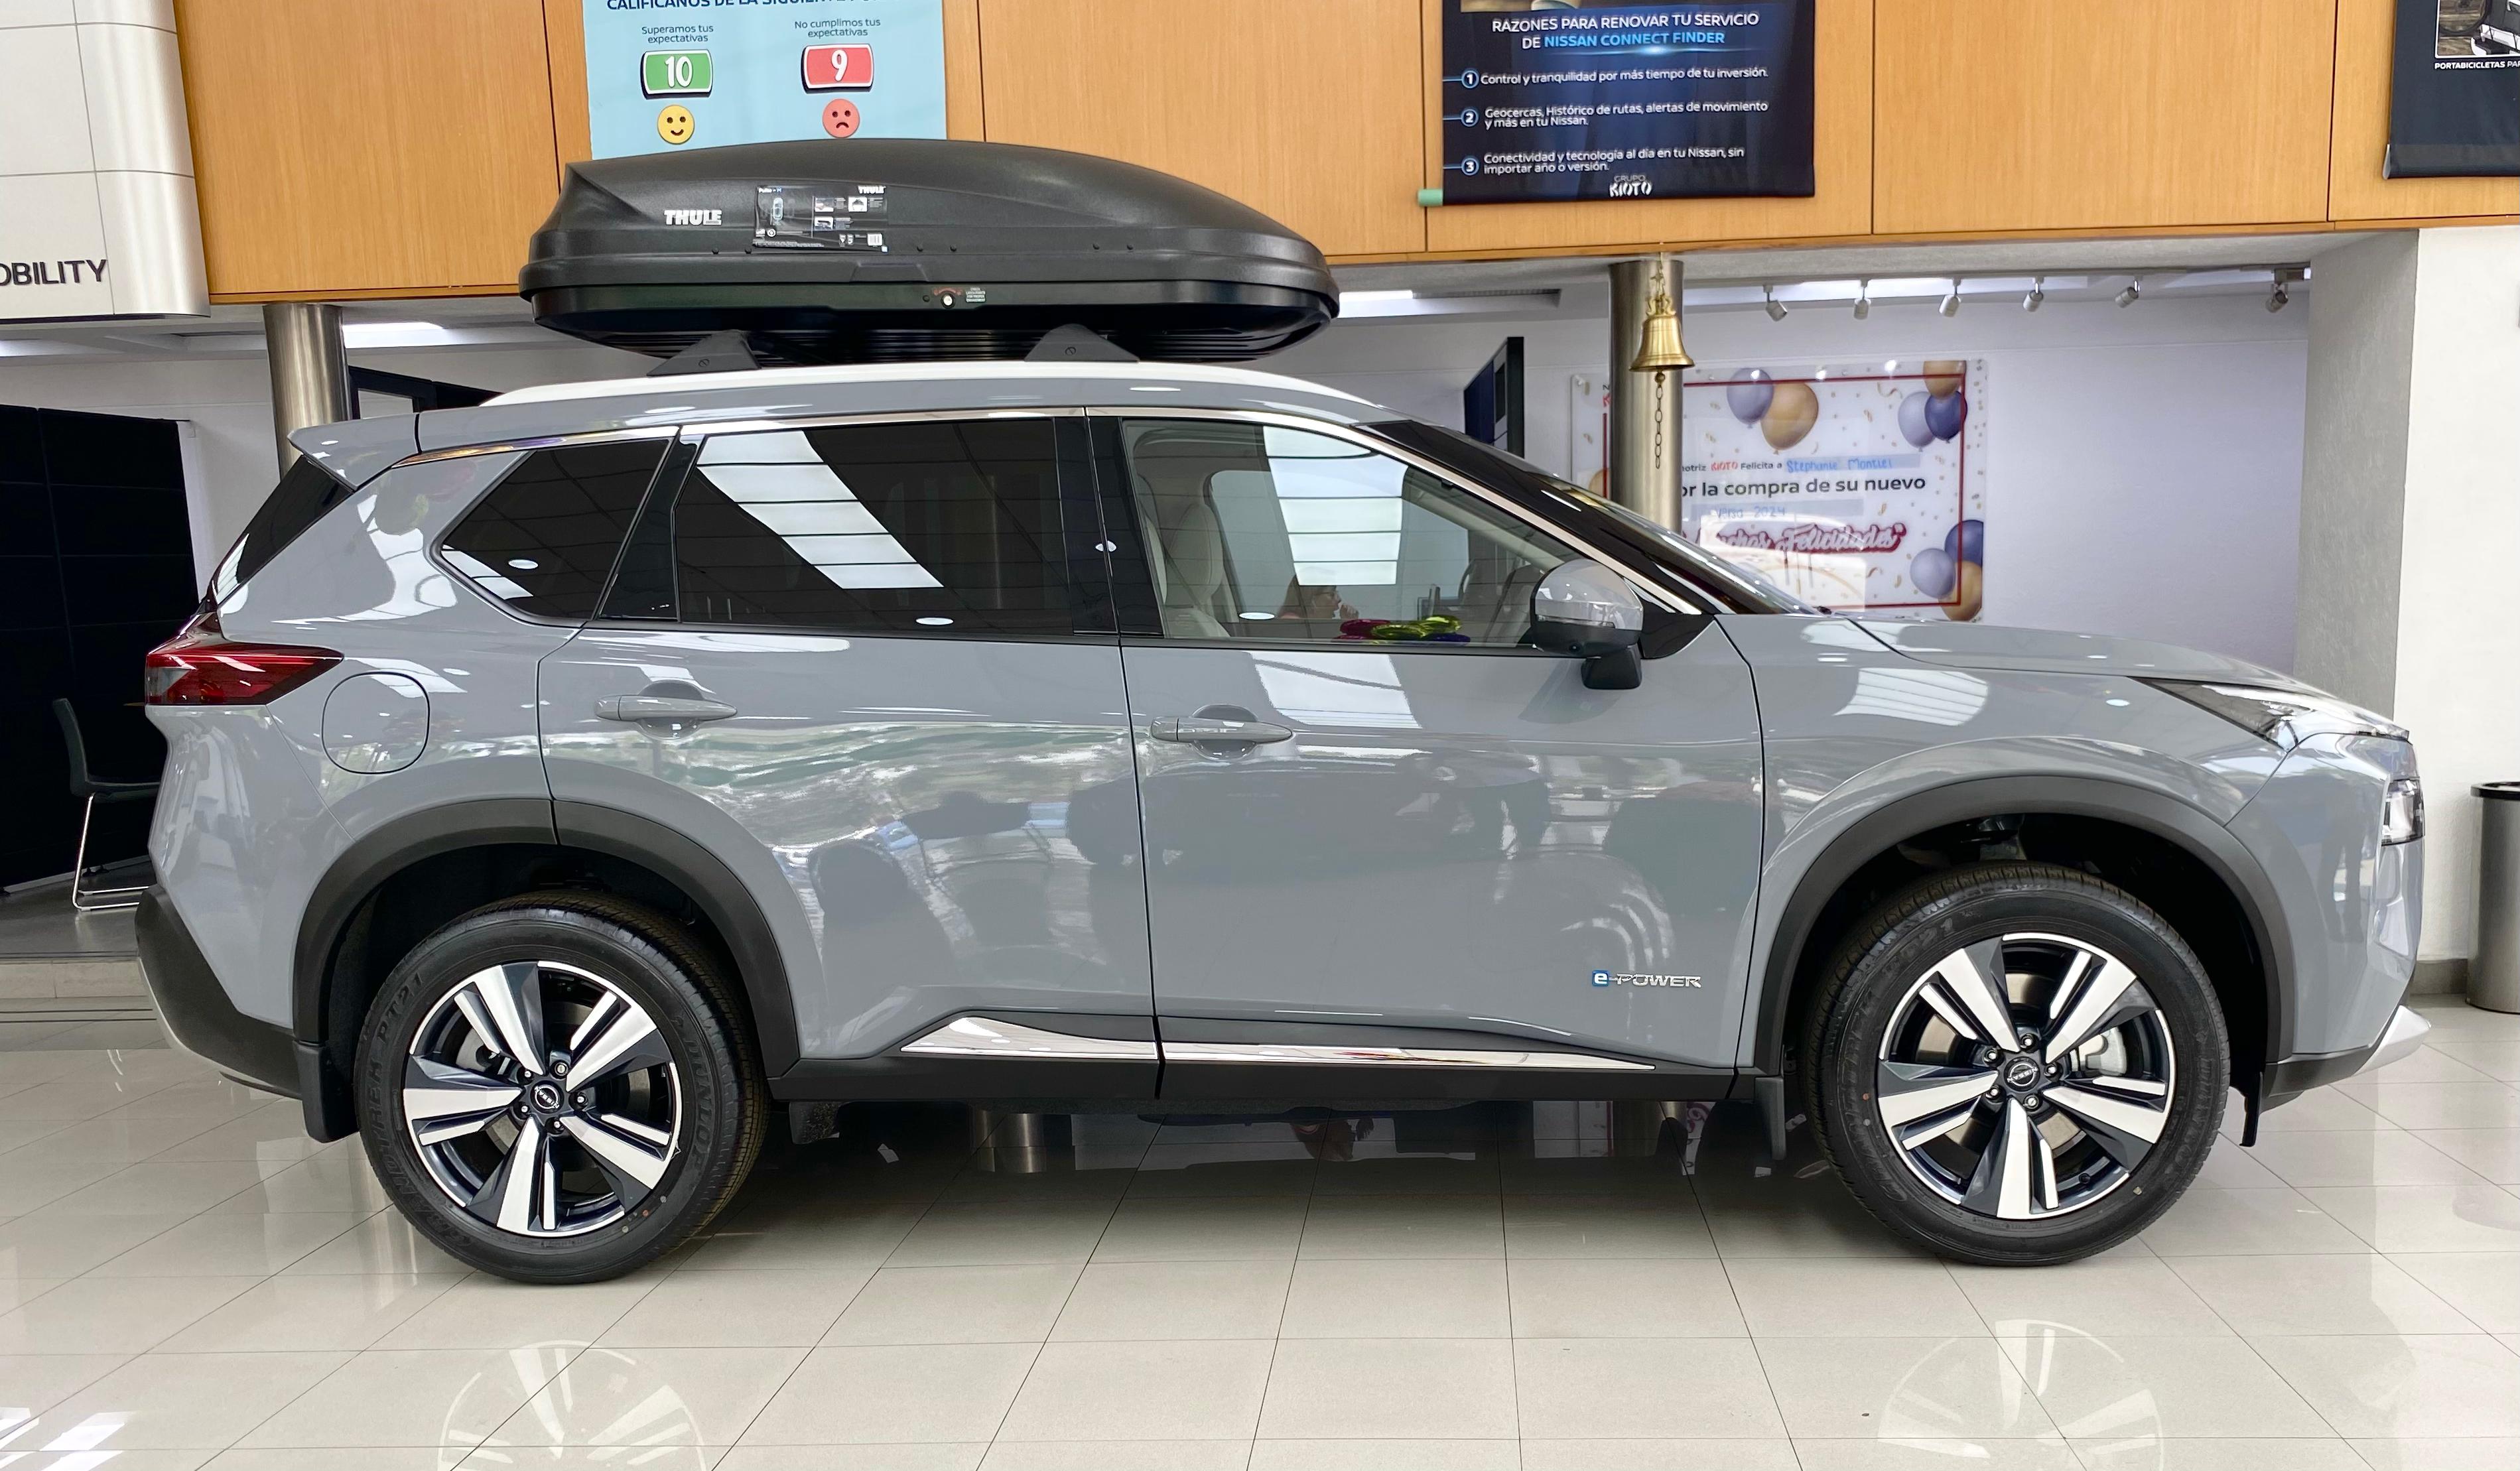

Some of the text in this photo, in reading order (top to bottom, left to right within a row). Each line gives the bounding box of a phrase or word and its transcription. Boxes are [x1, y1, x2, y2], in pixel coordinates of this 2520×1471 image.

[641, 25, 714, 35] Superamos tus
[795, 18, 881, 29] No cumplimos tus
[1492, 13, 1759, 32] RAZONES PARA RENOVAR TU SERVICIO
[647, 34, 708, 44] expectativas
[808, 28, 868, 39] expectativas
[1522, 32, 1725, 49] DE NISSAN CONNECT FINDER
[665, 55, 693, 88] 10
[831, 50, 848, 82] 9
[2434, 61, 2505, 70] PORTABICICLETAS
[1466, 66, 1768, 86] 1 Control y tranquilidad por más tiempo de tu inversión.
[1465, 101, 1768, 123] 2 Geocercas, Histórico de rutas, alertas de movimiento
[1485, 116, 1589, 130] y más en tu Nissan.
[1465, 147, 1745, 172] 3 Conectividad y tecnología al día en tu Nissan, sin
[1484, 161, 1609, 176] importar año o versión.
[858, 185, 886, 194] THULE
[1609, 181, 1652, 197] KIOTO
[664, 210, 722, 225] THULE
[1711, 462, 1738, 472] KIOTO
[1741, 462, 1773, 470] Felicita
[1702, 482, 1718, 496] la
[1725, 482, 1800, 498] compra
[1806, 478, 1830, 493] de
[1835, 480, 1857, 492] su
[1865, 477, 1926, 491] nuevo
[1594, 972, 1701, 988] e-POWER
[2007, 1066, 2039, 1083] NISSAN
[534, 1085, 561, 1109] NISSAN
